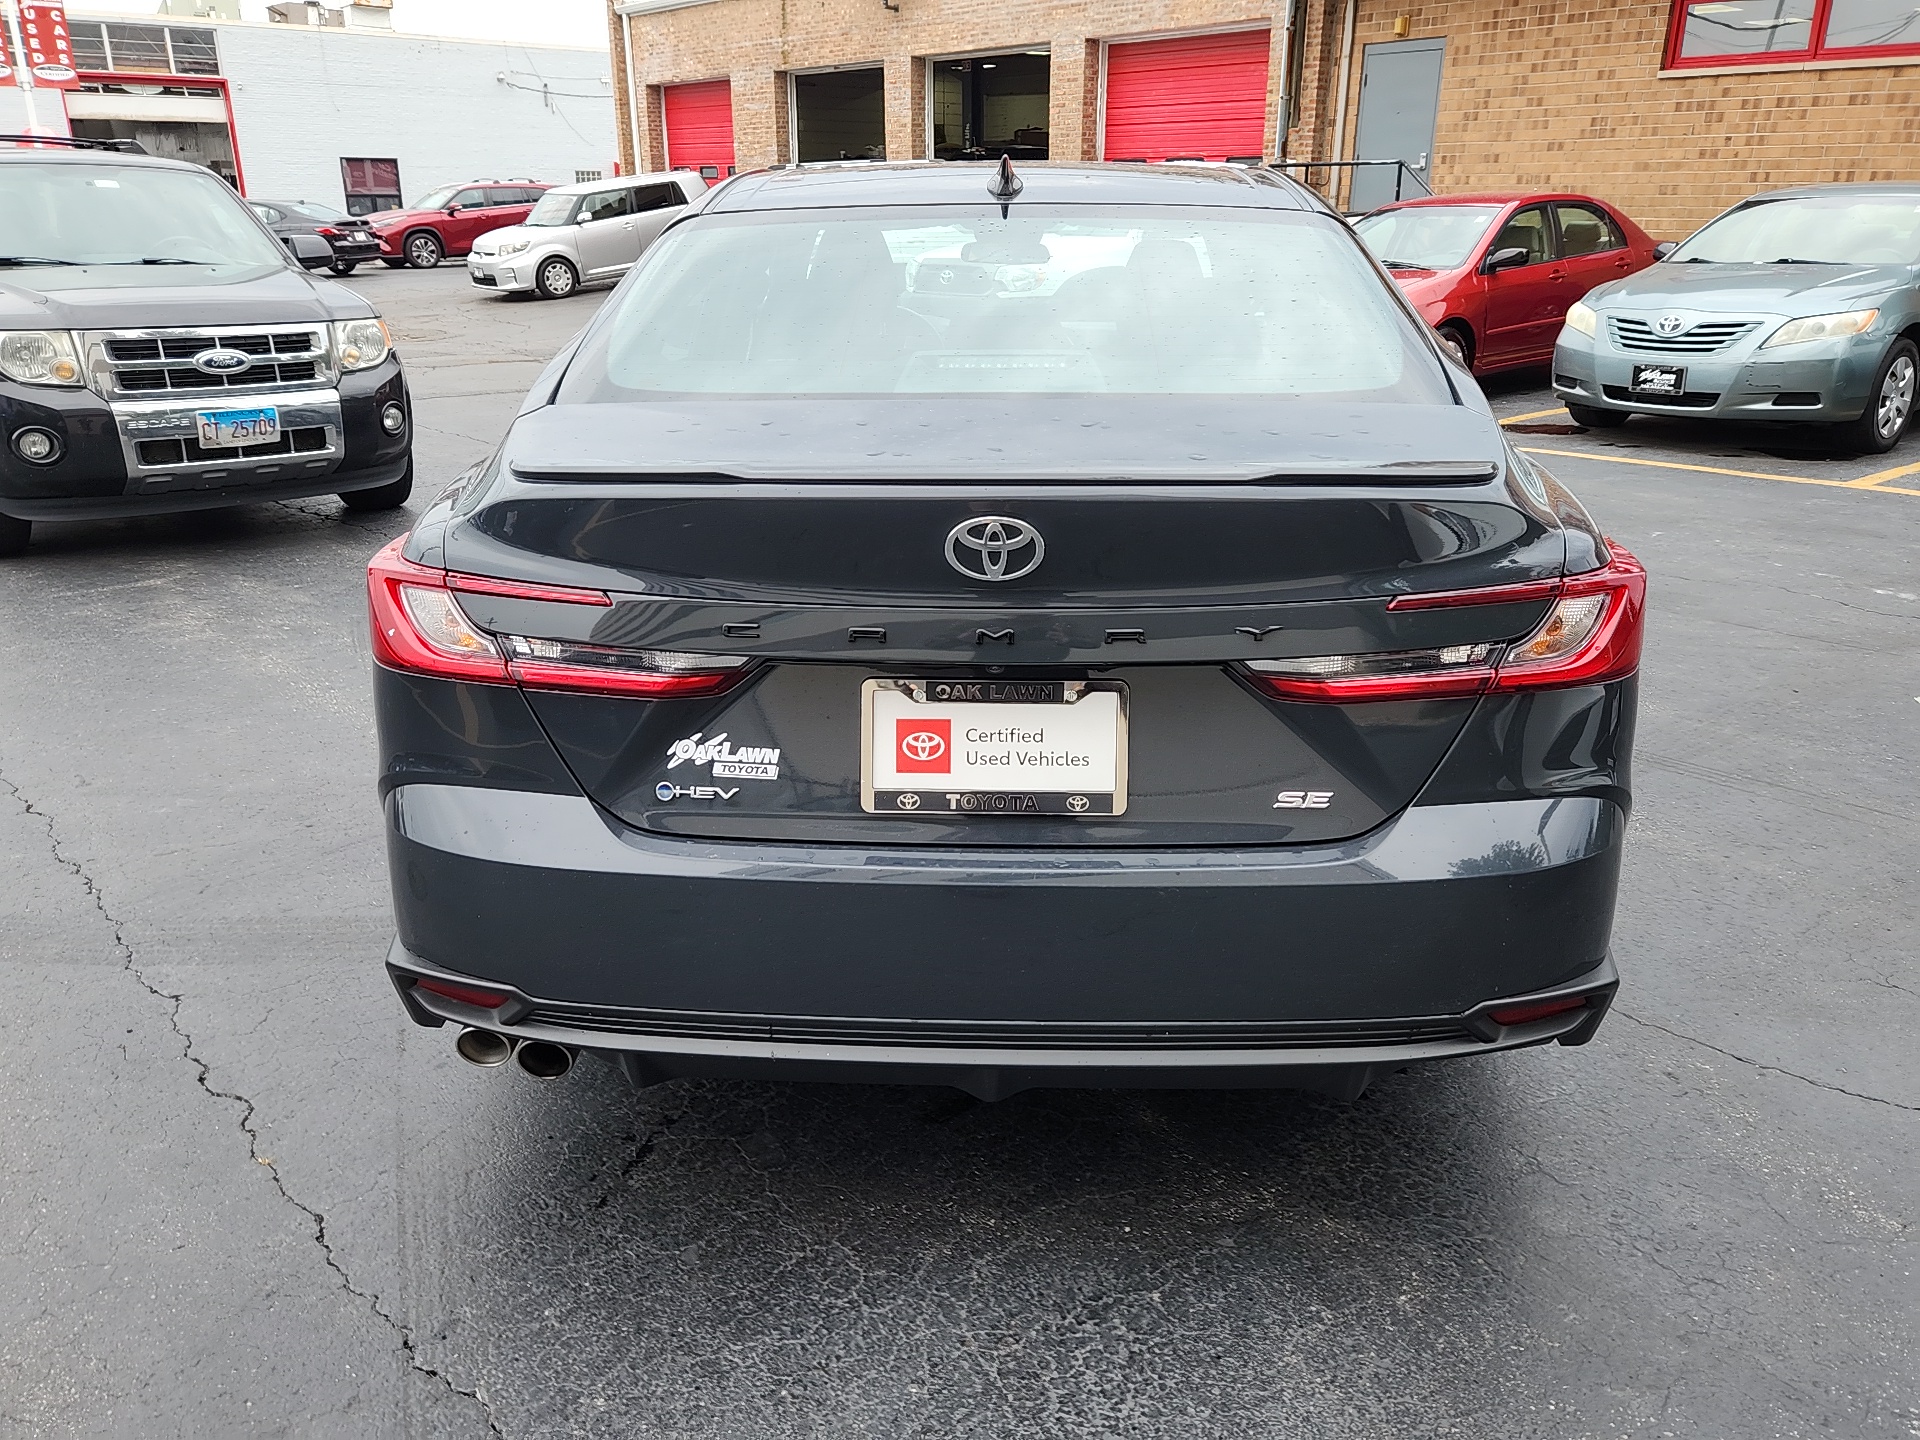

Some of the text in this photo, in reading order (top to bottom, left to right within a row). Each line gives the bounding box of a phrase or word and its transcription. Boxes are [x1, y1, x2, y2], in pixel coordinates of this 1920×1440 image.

[23, 8, 46, 64] USED
[50, 10, 71, 65] CARS
[211, 356, 238, 367] Ford
[127, 418, 191, 429] ESCAPE
[202, 418, 276, 440] CT 25709
[722, 622, 1284, 644] CAMRY
[935, 684, 1054, 701] OAK LAWN
[965, 728, 1044, 743] Certified
[966, 751, 1090, 767] Used Vehicles
[721, 764, 769, 775] TOYOTA
[674, 785, 740, 800] HEV
[1272, 791, 1335, 809] SE
[946, 794, 1039, 812] TOYOTA
